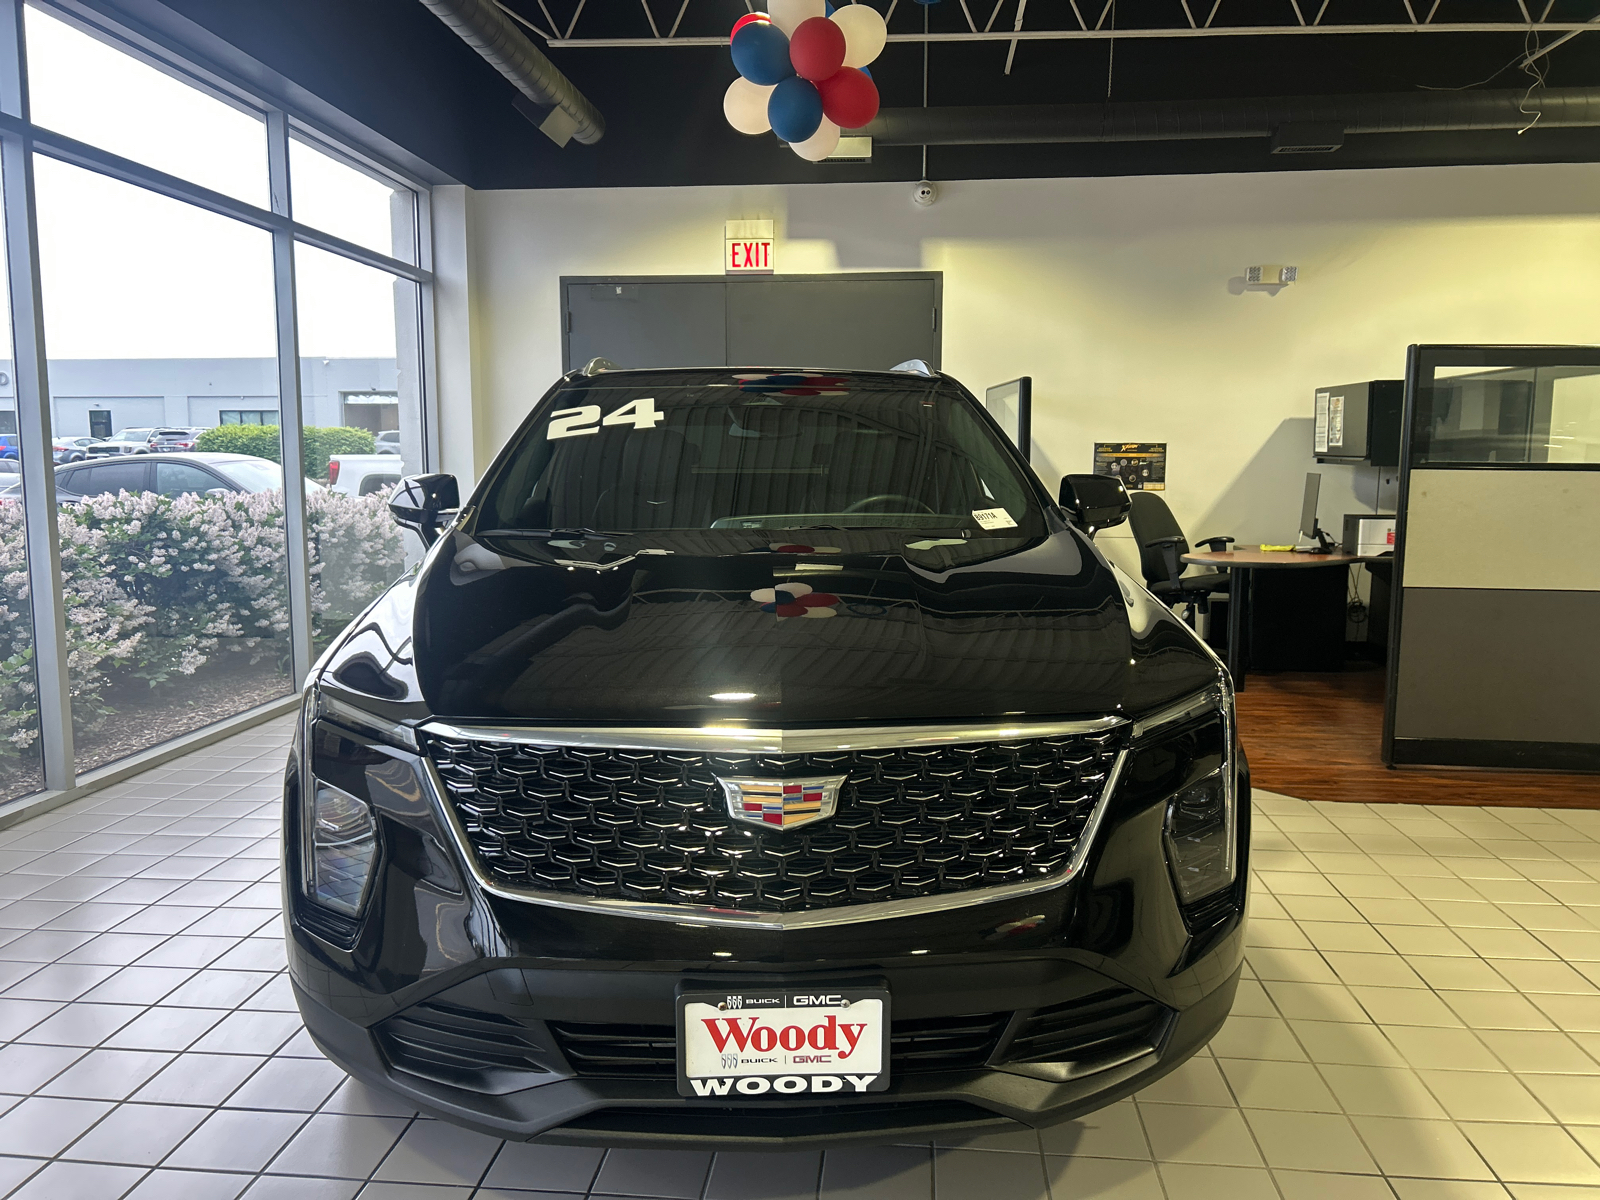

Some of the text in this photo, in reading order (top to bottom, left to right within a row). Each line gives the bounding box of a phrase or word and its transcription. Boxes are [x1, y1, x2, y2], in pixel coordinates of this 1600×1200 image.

[732, 242, 770, 268] EXIT
[547, 398, 665, 440] 24
[793, 994, 842, 1006] GMC
[701, 1015, 867, 1059] Woody
[793, 1055, 832, 1064] GMC
[690, 1075, 878, 1097] WOODY
